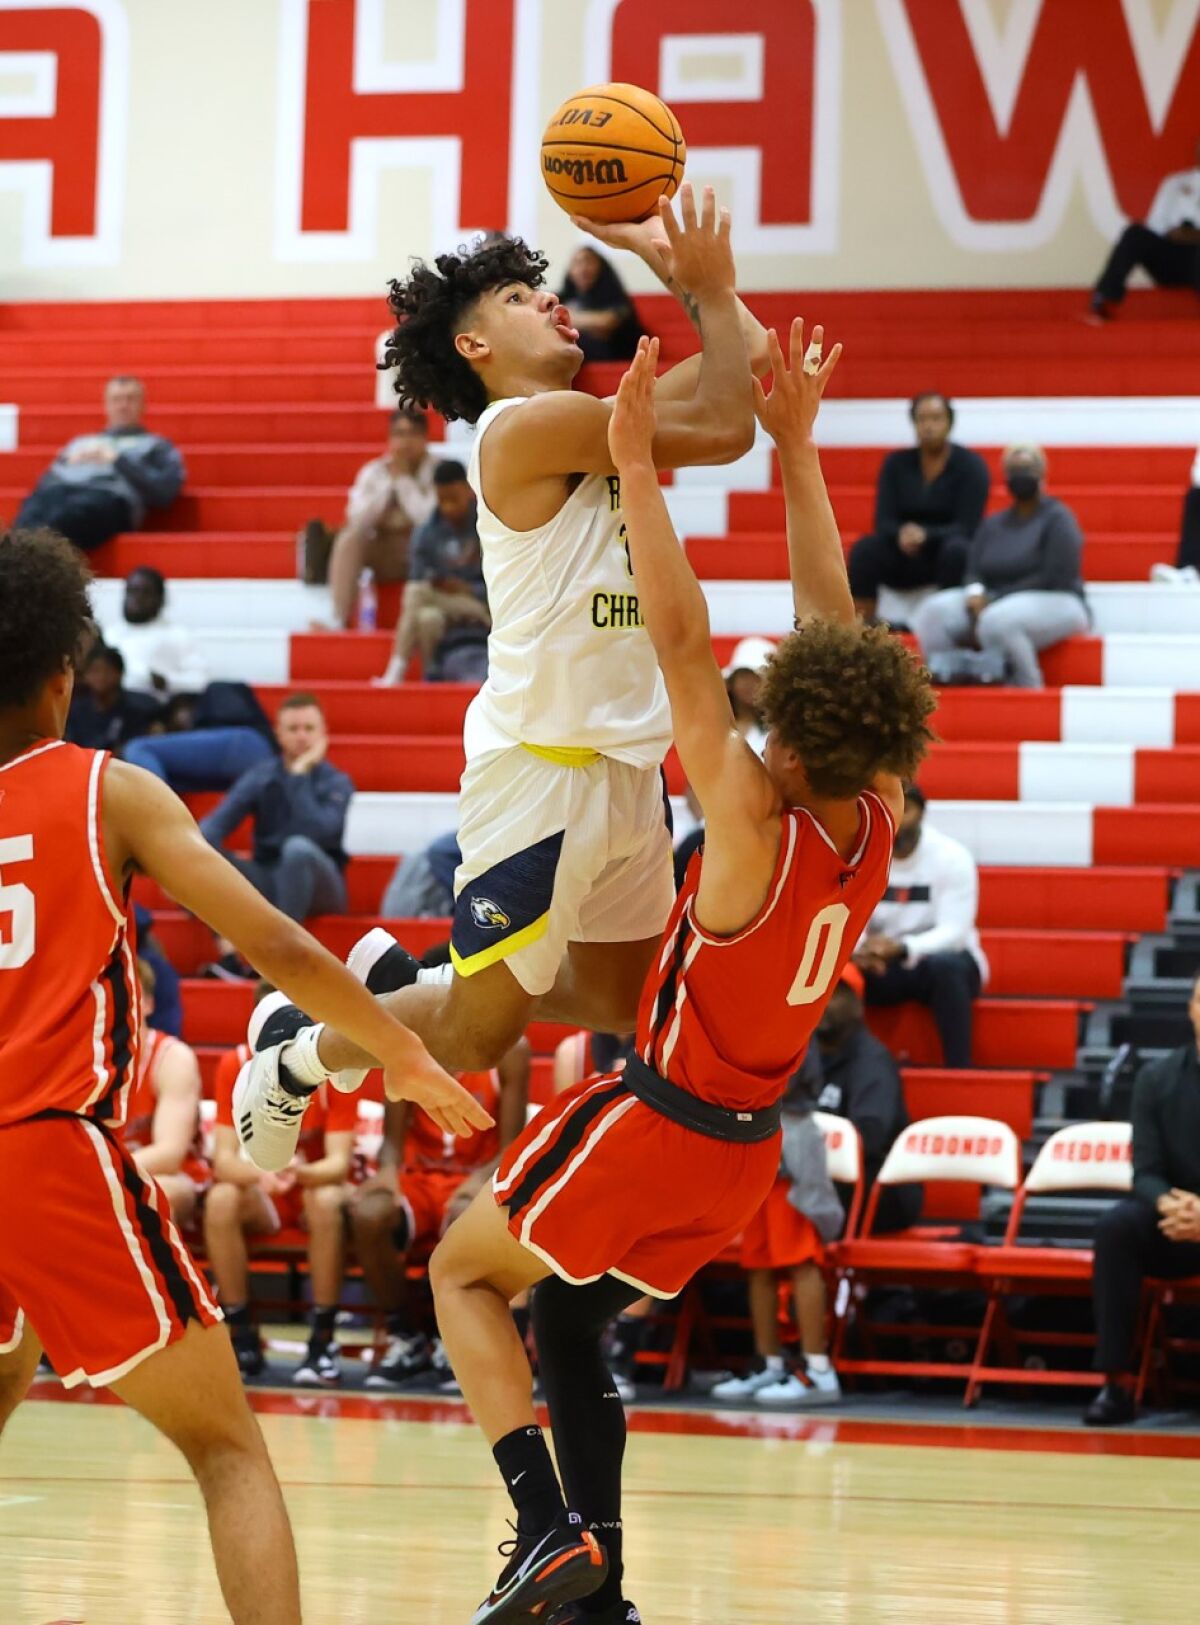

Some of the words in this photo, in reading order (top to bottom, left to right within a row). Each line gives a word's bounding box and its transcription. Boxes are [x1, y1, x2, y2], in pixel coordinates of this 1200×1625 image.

[544, 153, 628, 185] Wilson
[592, 592, 645, 628] CHR
[785, 902, 850, 1007] 0
[904, 1133, 1004, 1157] REDONDO
